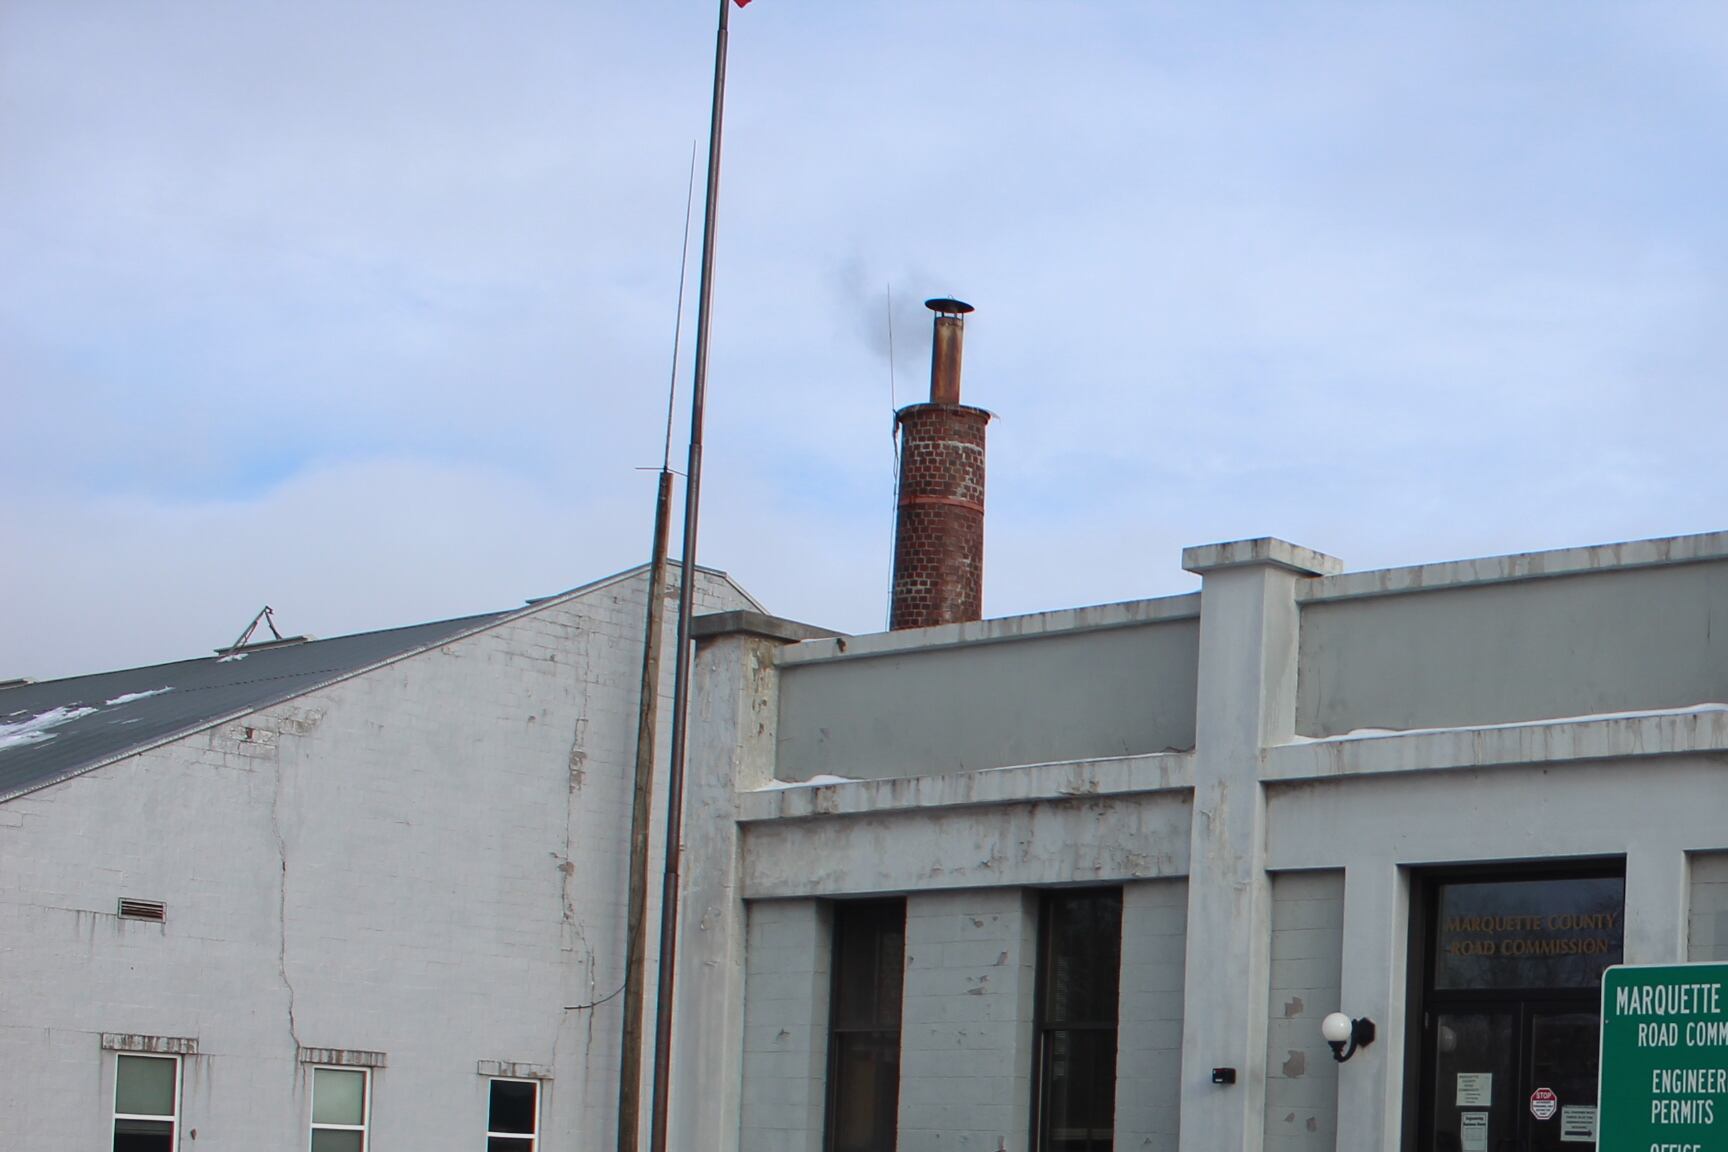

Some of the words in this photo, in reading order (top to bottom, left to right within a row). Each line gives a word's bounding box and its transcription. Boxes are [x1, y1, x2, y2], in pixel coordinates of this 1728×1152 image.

[1447, 915, 1541, 933] MARQUETTE
[1549, 913, 1616, 930] COUNTY
[1450, 940, 1495, 955] ROAD
[1502, 938, 1609, 955] COMMISSION
[1616, 984, 1721, 1016] MARQUETTE
[1638, 1023, 1678, 1047] ROAD
[1535, 1091, 1552, 1099] STOP
[1651, 1100, 1714, 1125] PERMITS
